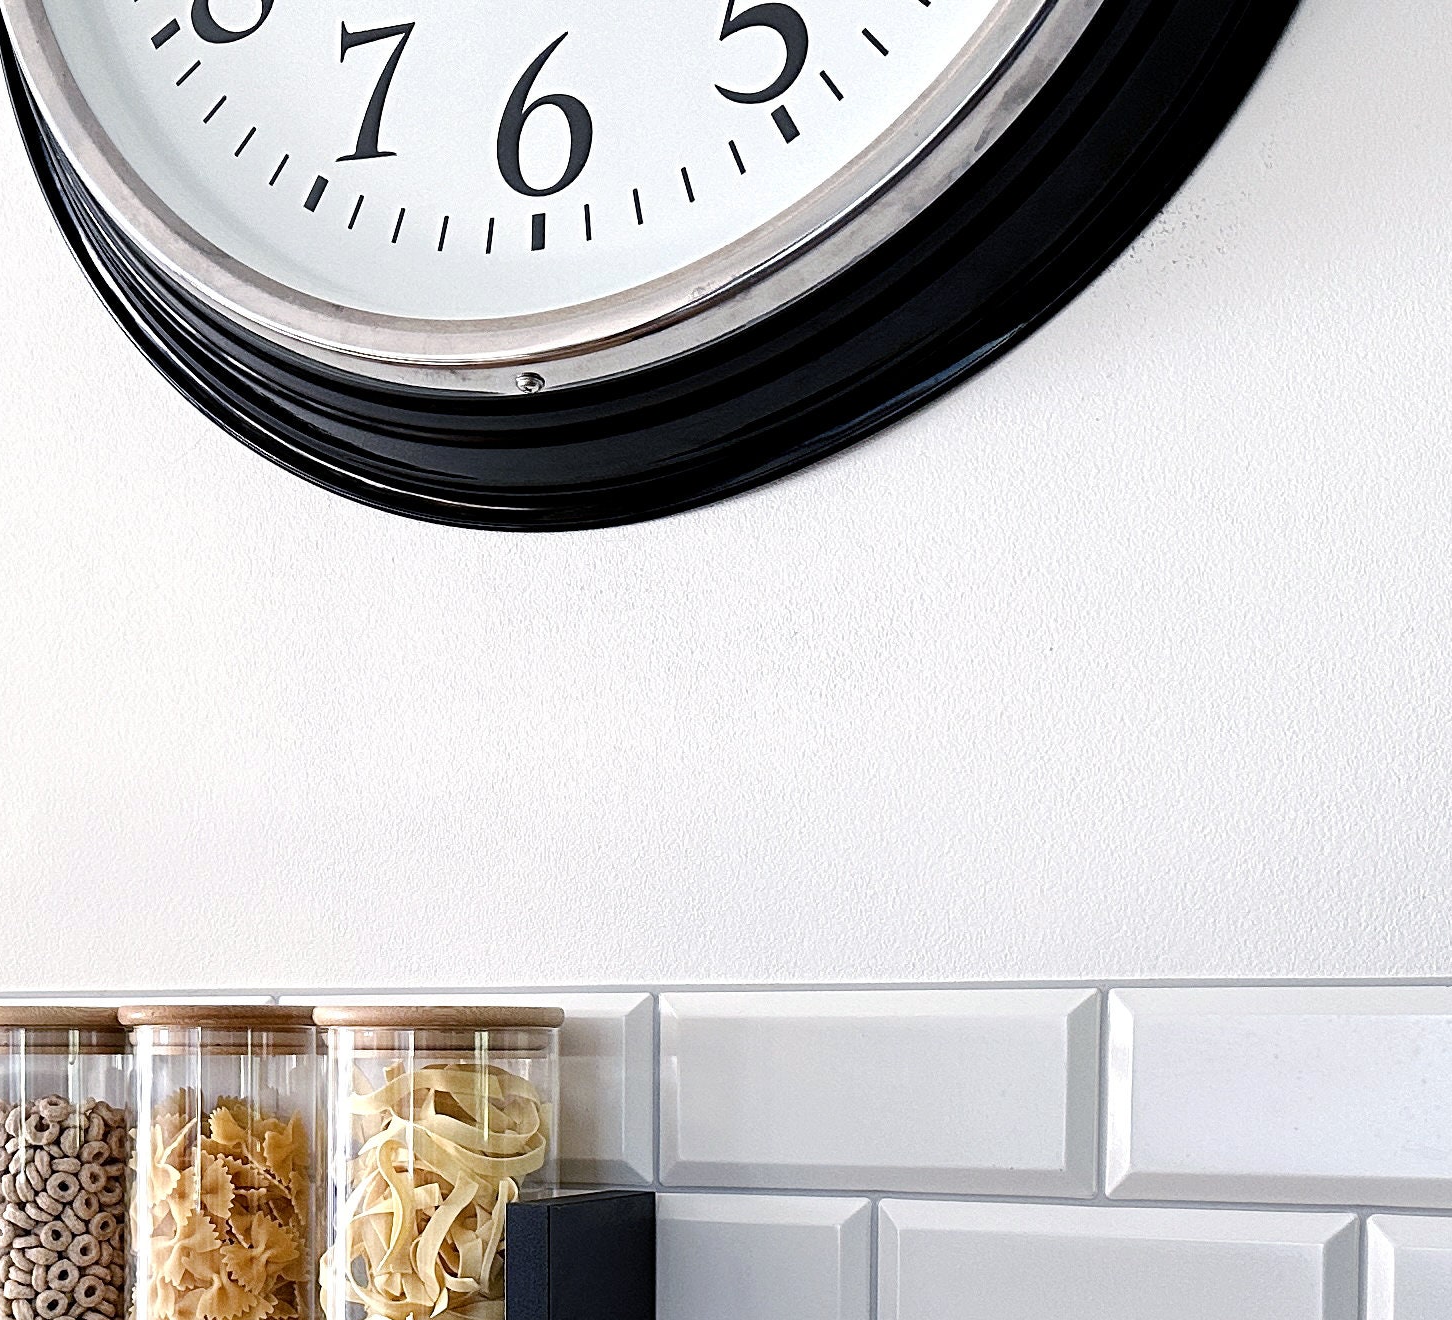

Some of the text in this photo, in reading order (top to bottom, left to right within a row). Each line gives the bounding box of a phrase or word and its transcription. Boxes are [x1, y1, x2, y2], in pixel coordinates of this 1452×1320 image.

[336, 22, 416, 161] 7
[497, 32, 593, 196] 6
[714, 0, 809, 104] 5
